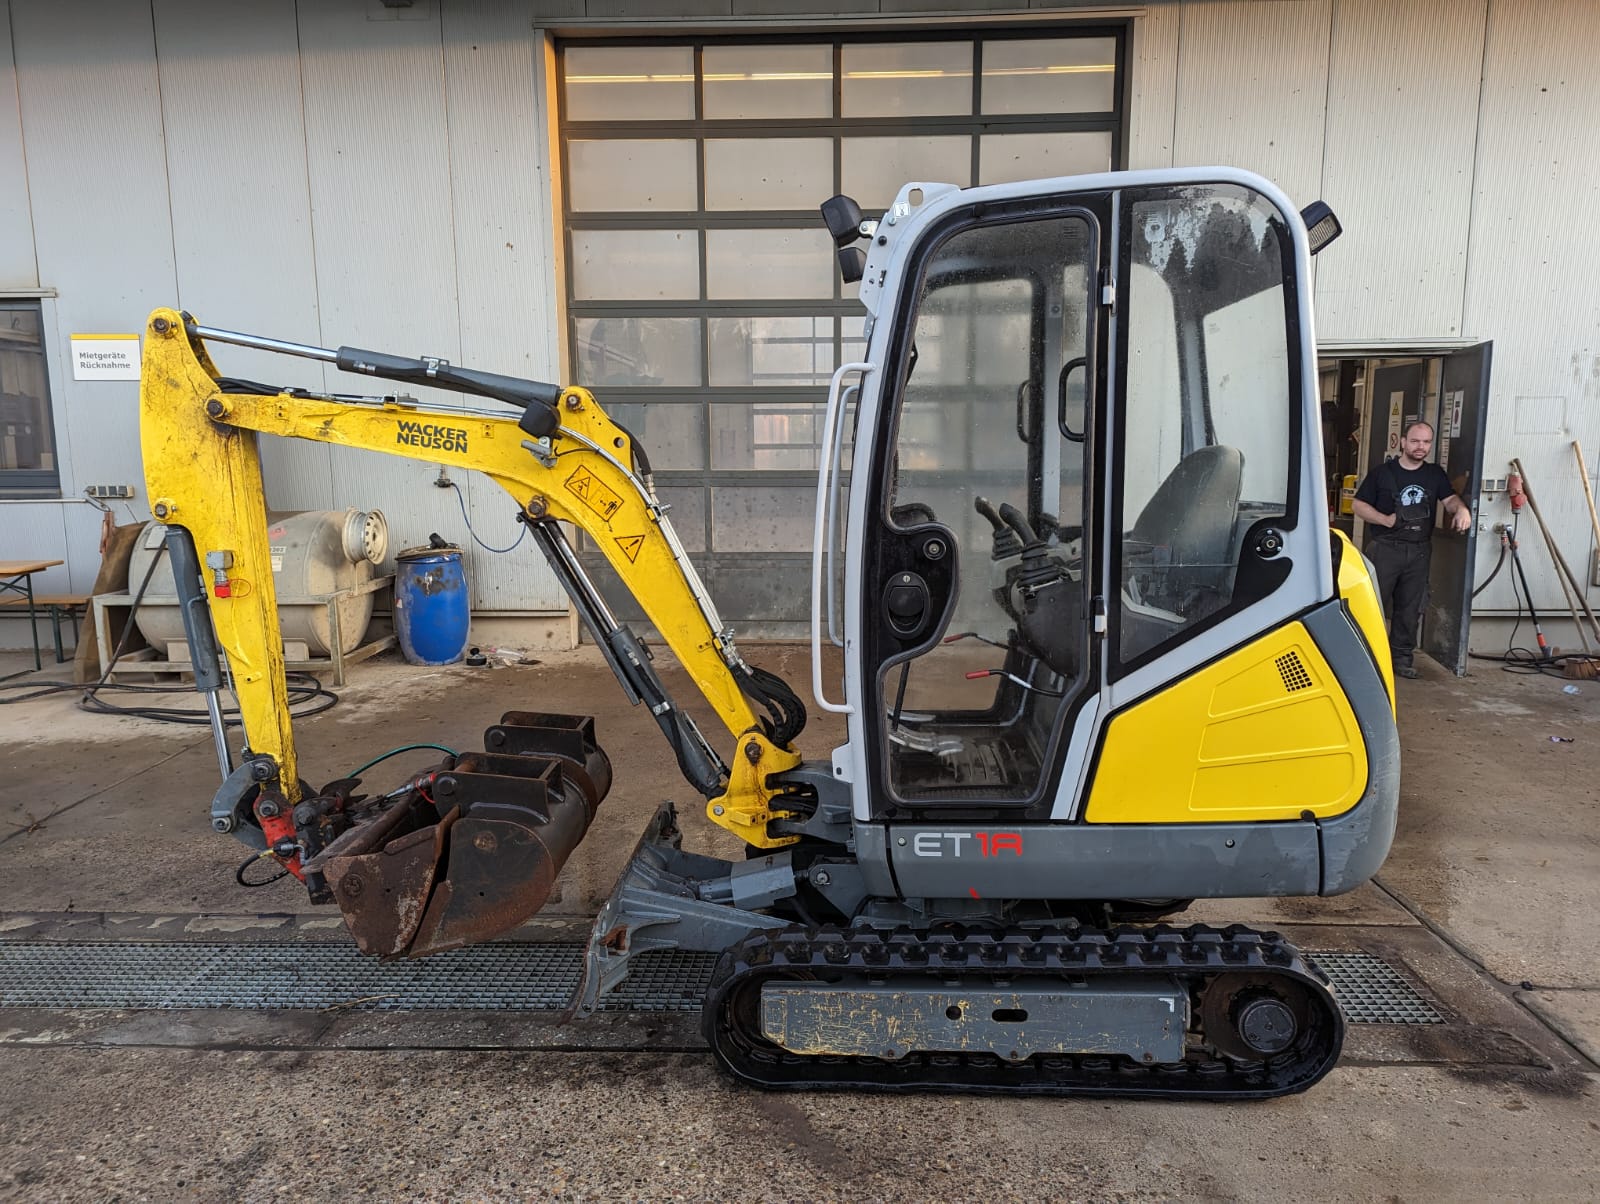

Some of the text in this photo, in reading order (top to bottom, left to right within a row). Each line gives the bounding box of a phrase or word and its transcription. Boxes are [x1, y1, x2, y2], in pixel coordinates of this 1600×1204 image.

[79, 352, 126, 360] Mietgeräte
[80, 361, 131, 369] Rücknahme
[397, 420, 467, 442] WACKER
[396, 431, 468, 453] NEUSON
